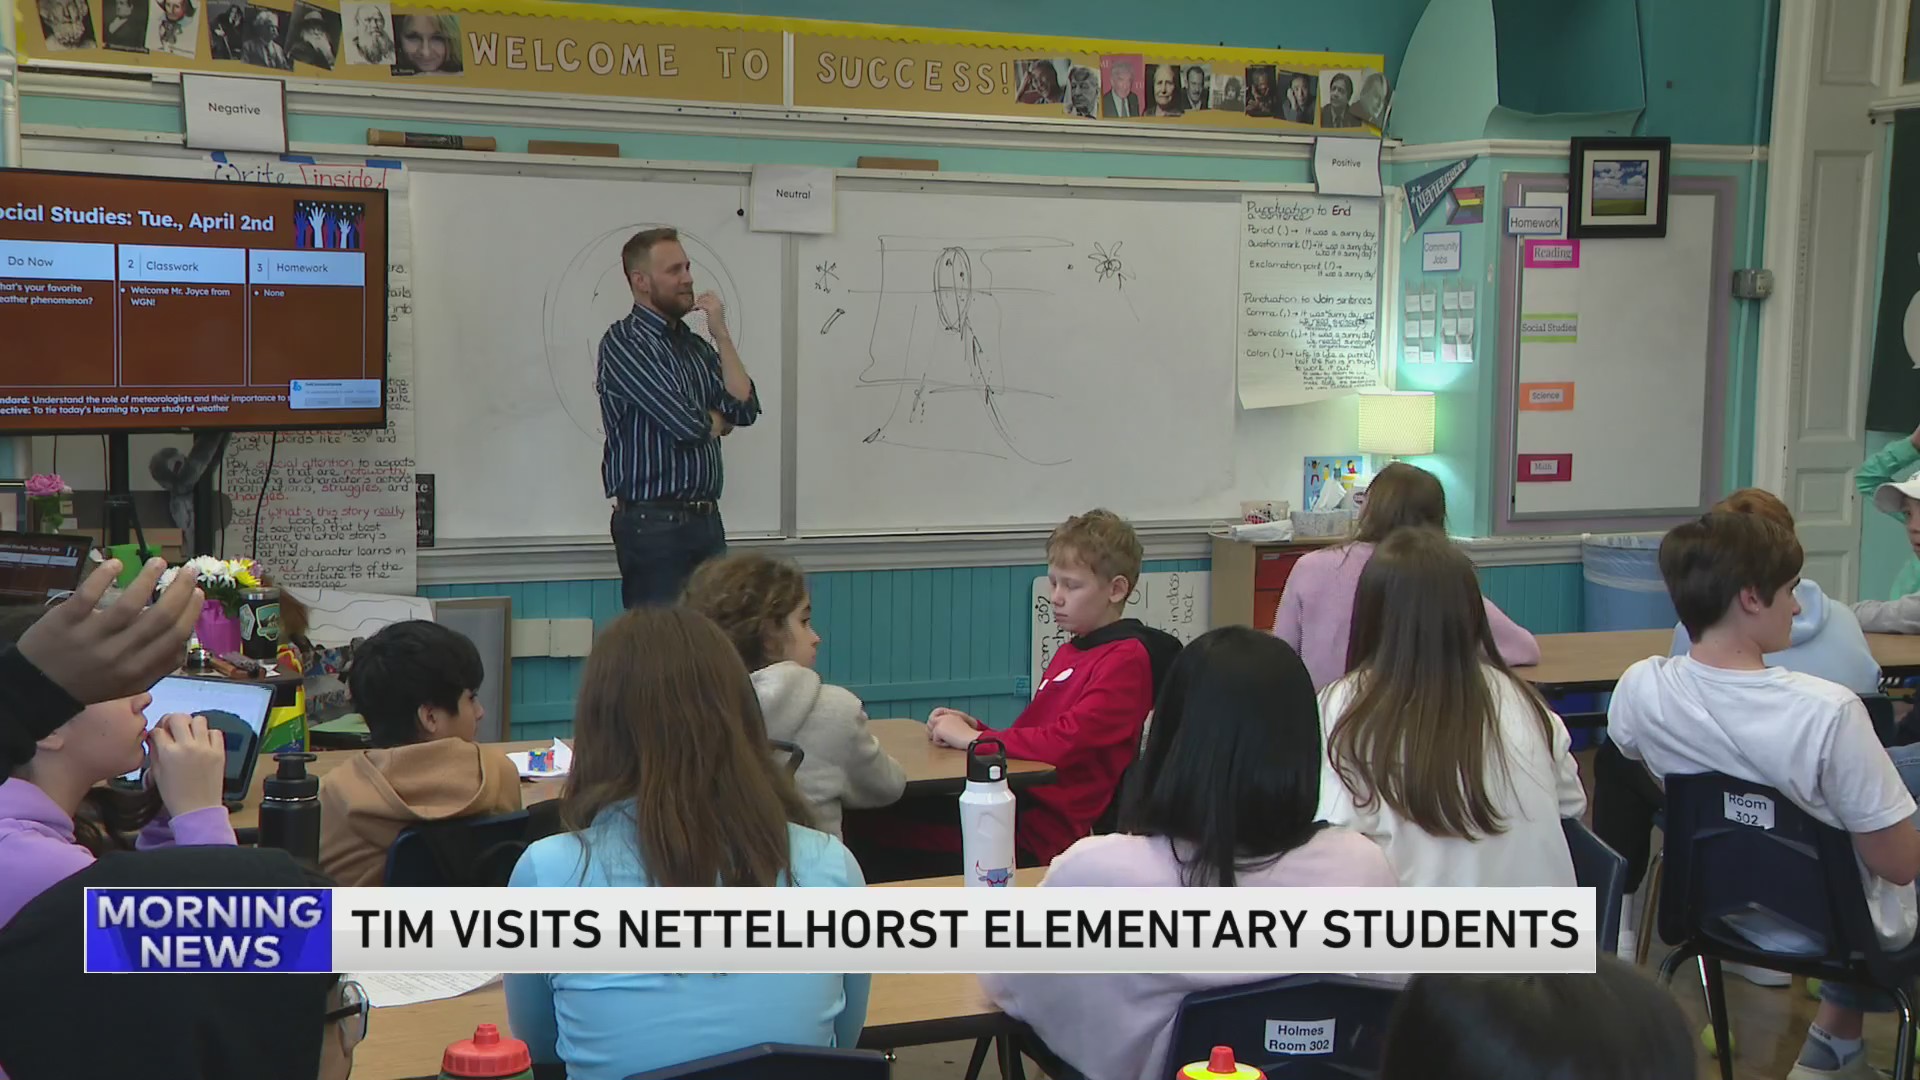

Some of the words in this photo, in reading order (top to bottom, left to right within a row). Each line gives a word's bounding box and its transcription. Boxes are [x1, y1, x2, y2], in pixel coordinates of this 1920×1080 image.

[468, 31, 680, 77] WELCOME
[716, 46, 770, 81] TO
[816, 51, 1009, 94] SUCCESS!
[208, 102, 261, 116] Negative
[1331, 158, 1361, 168] Positive
[776, 189, 811, 200] Neutral
[1317, 204, 1327, 216] to
[1331, 205, 1352, 217] End
[0, 202, 43, 222] ocial
[50, 205, 132, 226] Studies:
[138, 210, 183, 232] Tue.,
[188, 212, 235, 233] April
[240, 215, 275, 232] 2nd
[1510, 217, 1560, 229] Homework
[1424, 242, 1459, 252] Community
[1534, 247, 1572, 259] Reading
[8, 256, 24, 266] Do
[27, 256, 54, 267] Now
[1432, 255, 1448, 264] Jobs
[128, 259, 134, 269] 2
[145, 261, 199, 272] Classwork
[257, 263, 263, 272] 3
[276, 262, 329, 273] Homework
[0, 282, 22, 292] hat's
[24, 285, 45, 294] your
[47, 284, 82, 293] favorite
[130, 286, 170, 295] Welcome
[171, 287, 184, 296] Mr.
[185, 287, 210, 298] Joyce
[211, 287, 231, 296] from
[263, 288, 285, 297] None
[0, 295, 28, 304] eather
[30, 296, 93, 306] phenomenon?
[131, 297, 156, 306] WGN!
[1522, 323, 1546, 332] Social
[1547, 323, 1577, 332] Studies
[32, 395, 84, 404] Understand
[86, 395, 100, 403] the
[102, 395, 118, 403] role
[119, 395, 129, 403] of
[130, 395, 192, 405] meteorologists
[211, 394, 230, 402] their
[232, 394, 276, 404] importance
[1532, 391, 1560, 401] Science
[33, 406, 43, 414] To
[45, 406, 57, 414] tie
[60, 406, 91, 415] today's
[93, 405, 128, 415] learning
[130, 405, 140, 413] to
[141, 405, 160, 415] your
[162, 405, 184, 414] study
[196, 405, 229, 413] weather
[376, 434, 397, 443] and
[1728, 794, 1768, 811] Room
[1735, 810, 1759, 825] 302
[1277, 1025, 1324, 1036] Holmes
[1269, 1039, 1306, 1051] Room
[1310, 1039, 1330, 1051] 302
